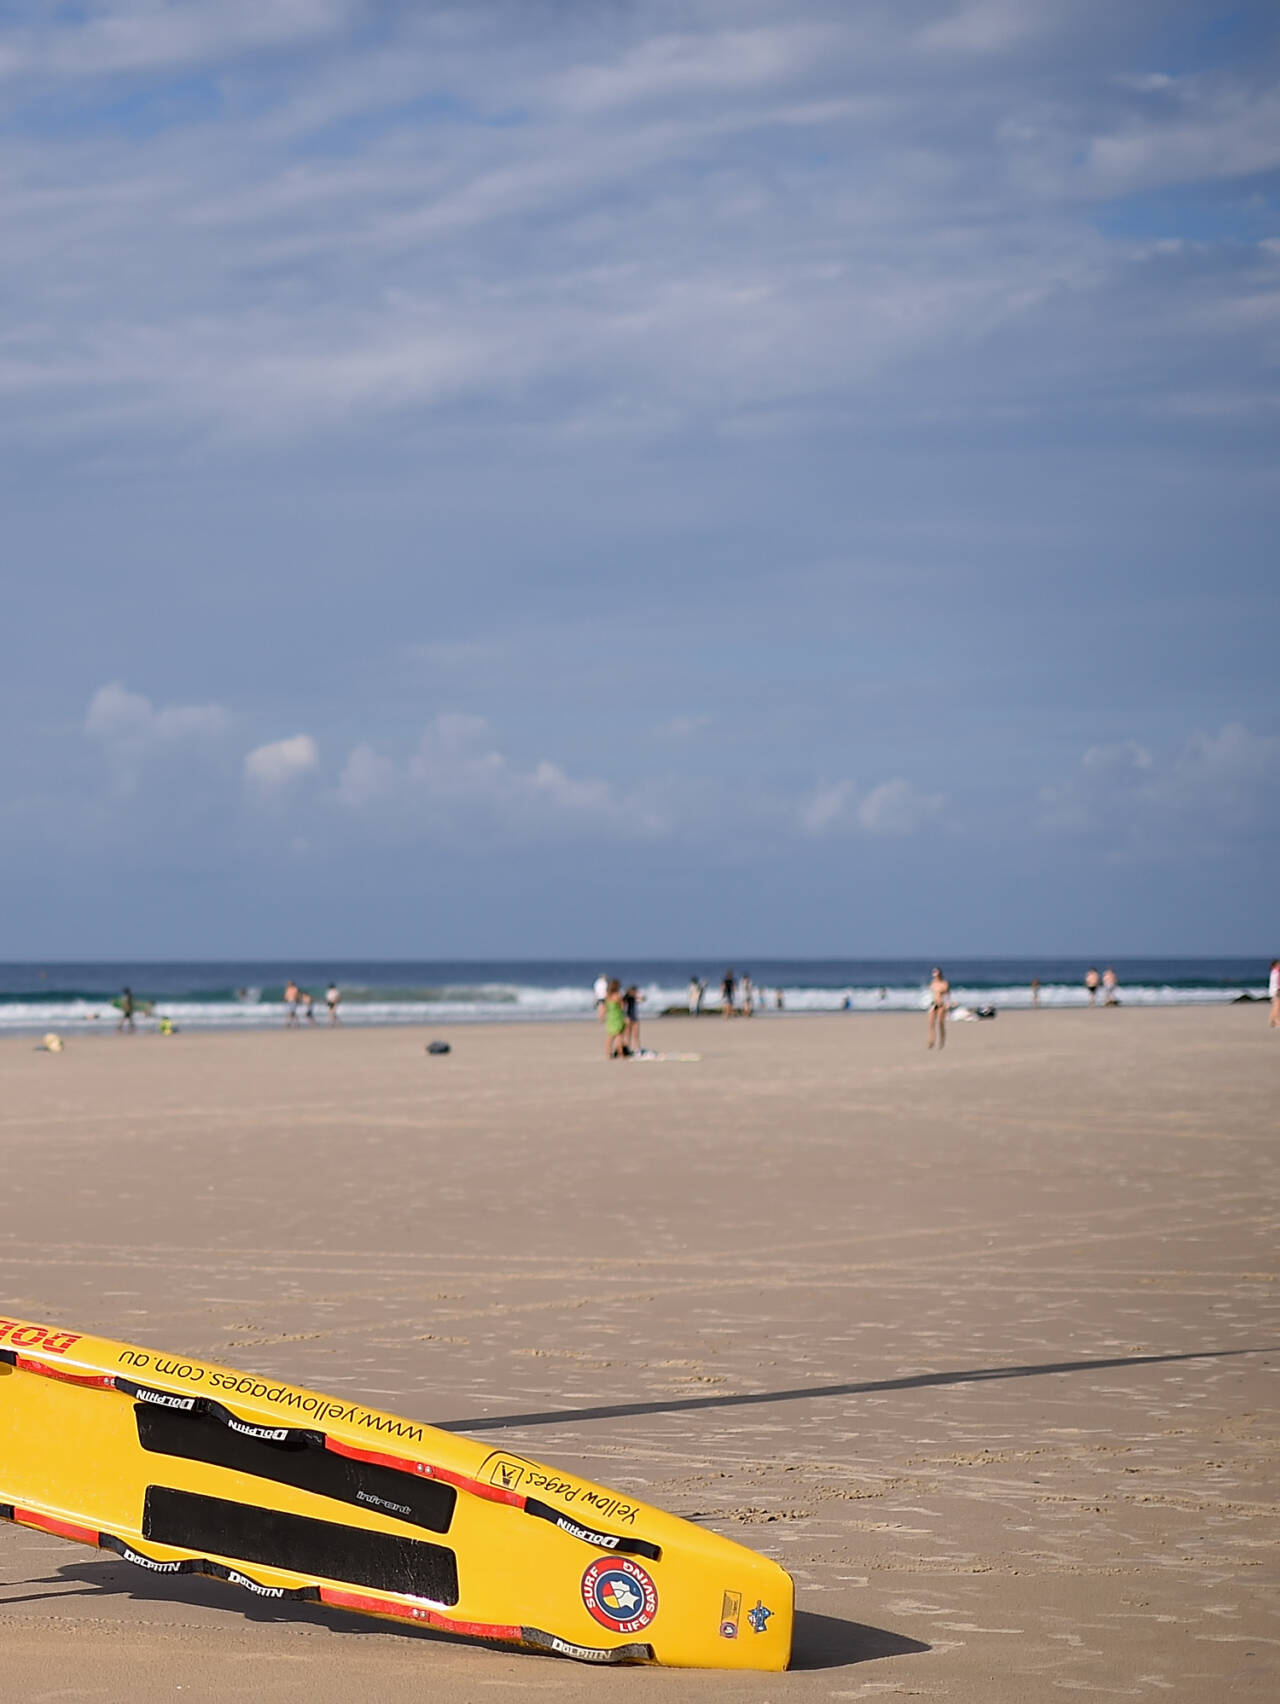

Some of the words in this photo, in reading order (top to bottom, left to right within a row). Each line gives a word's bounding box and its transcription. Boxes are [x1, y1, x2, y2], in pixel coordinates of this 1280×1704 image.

[118, 1350, 423, 1441] www.yellowpages.com.au
[136, 1389, 195, 1411] DOLPHIN
[227, 1419, 288, 1441] DOLPHIN
[525, 1472, 582, 1502] Pages
[581, 1491, 640, 1525] Yellow
[556, 1518, 620, 1549] DOLPHIN
[123, 1548, 181, 1572] DOLPHIN
[227, 1571, 284, 1598] DOLPHIN
[583, 1565, 599, 1609] SURF
[622, 1561, 657, 1613] SAVING
[619, 1614, 650, 1633] LIFE
[552, 1638, 612, 1660] DOLPHIN
